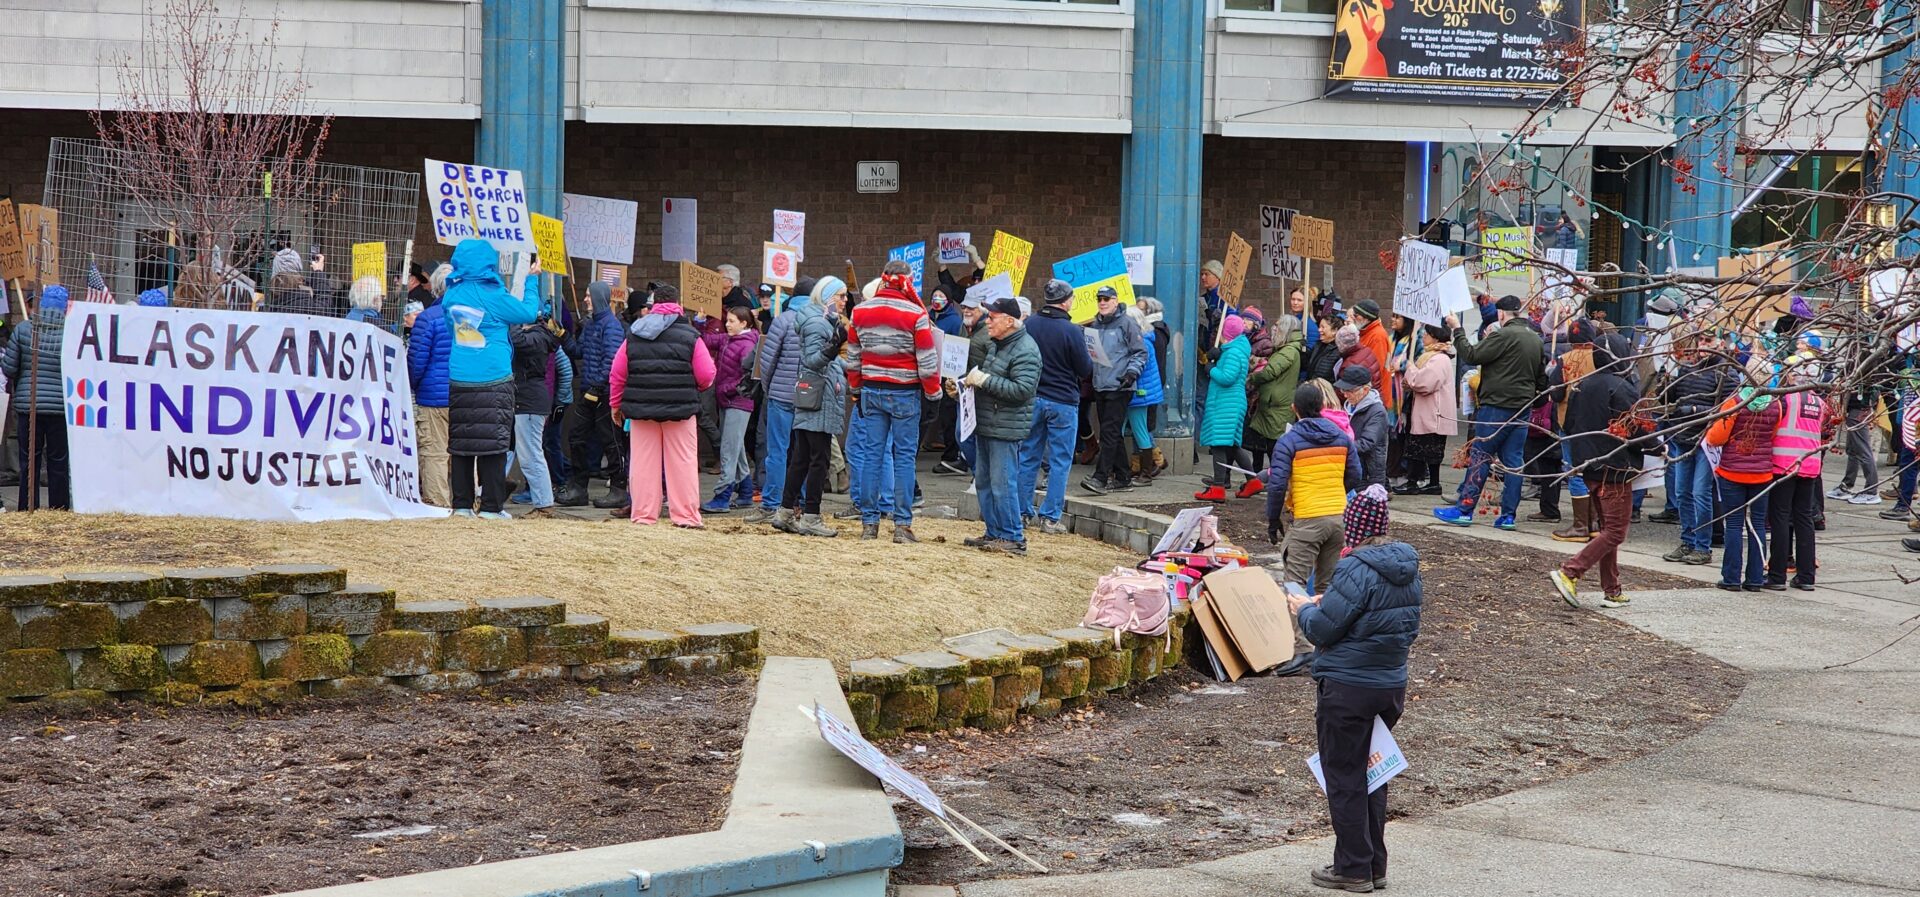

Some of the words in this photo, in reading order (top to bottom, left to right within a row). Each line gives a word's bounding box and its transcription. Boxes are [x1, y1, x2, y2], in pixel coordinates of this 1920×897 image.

[1443, 13, 1469, 27] 20's
[1401, 26, 1418, 34] Come
[1419, 27, 1441, 35] dressed
[1456, 28, 1475, 37] Flashy
[1502, 33, 1544, 45] Saturday,
[1430, 41, 1441, 50] live
[1442, 43, 1477, 52] performance
[1478, 45, 1486, 53] by
[1437, 50, 1456, 58] Fourth
[1457, 51, 1471, 59] Wall.
[1501, 47, 1532, 60] March
[1398, 61, 1442, 76] Benefit
[1445, 62, 1487, 77] Tickets
[1490, 66, 1502, 78] at
[1506, 66, 1559, 81] 272-7546
[443, 163, 508, 187] DEPT
[871, 166, 885, 177] NO
[860, 178, 897, 187] LOITERING
[440, 182, 523, 204] OLIGARCH
[440, 198, 519, 223] GREED
[436, 218, 524, 241] EVERYWHERE
[1293, 216, 1331, 238] SUPPORT
[1272, 231, 1284, 247] UP
[1290, 237, 1304, 256] OUR
[1486, 233, 1500, 243] NO
[1262, 244, 1289, 259] FIGHT
[1273, 259, 1299, 279] BACK
[361, 335, 395, 393] AE
[167, 445, 210, 480] NO
[217, 448, 361, 487] JUSTICE
[1382, 755, 1397, 773] DON'T
